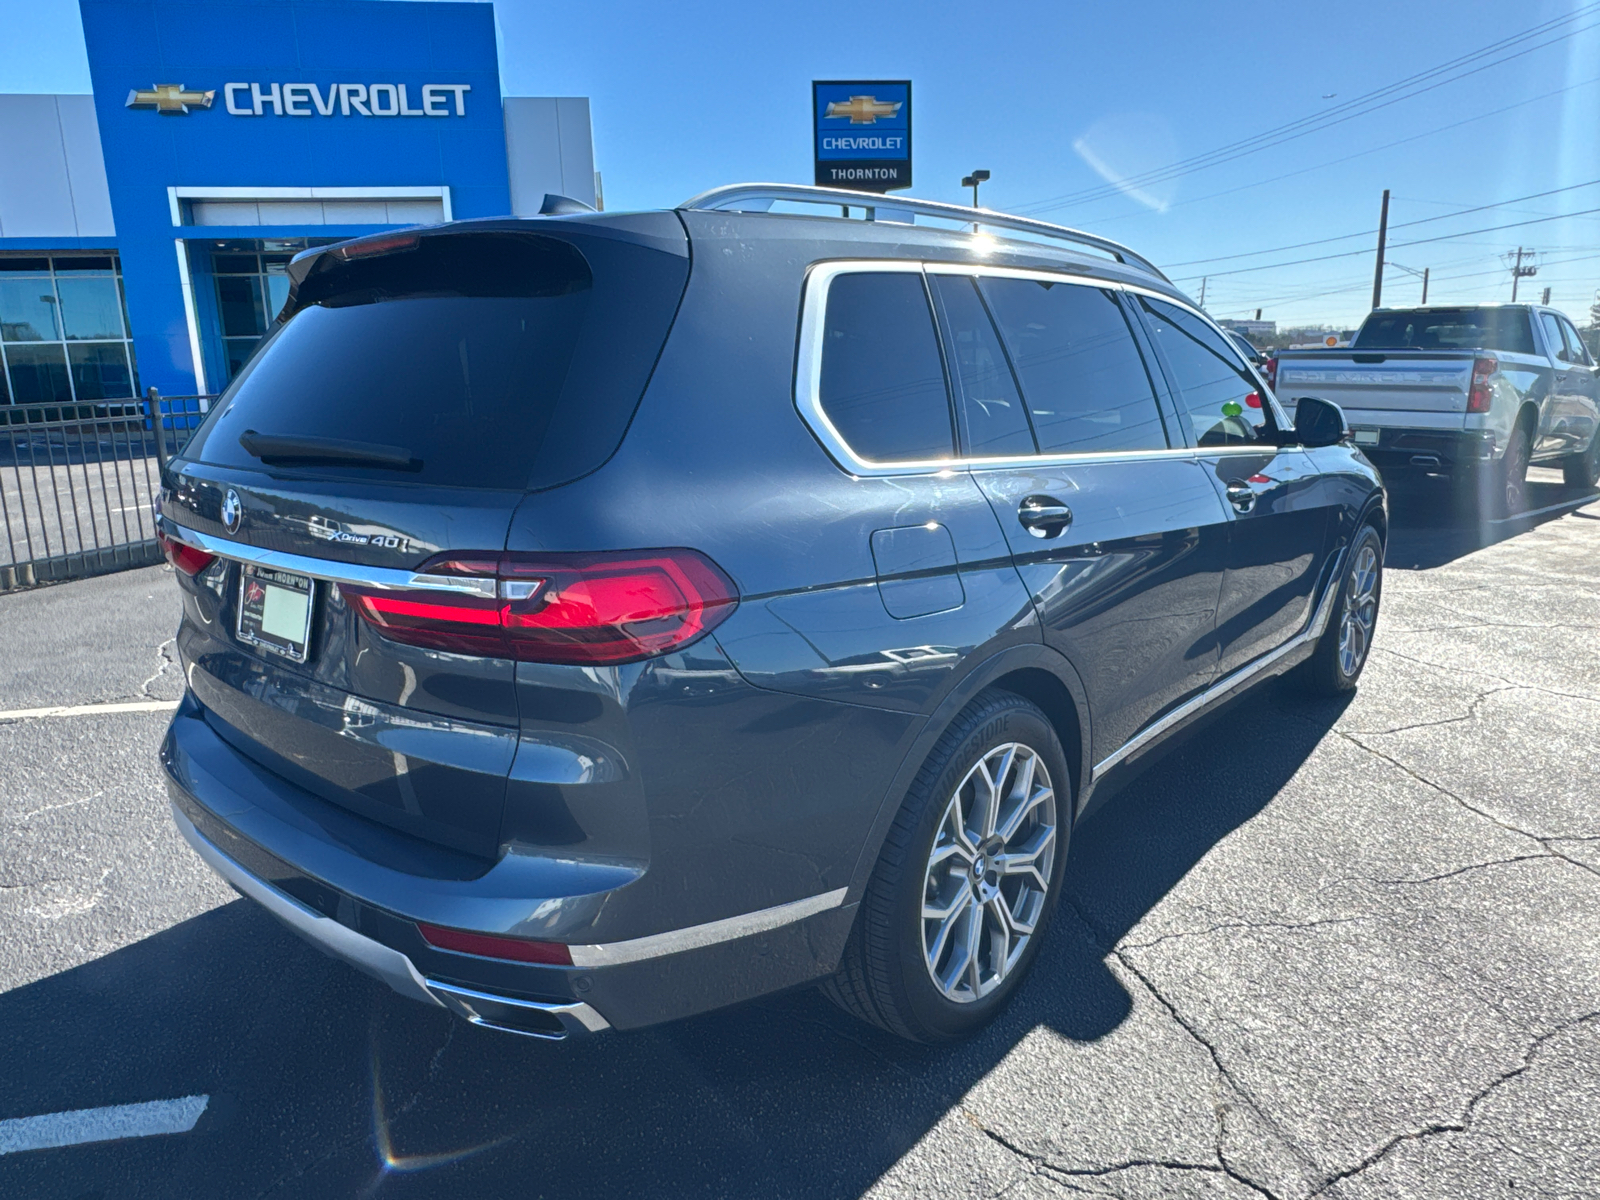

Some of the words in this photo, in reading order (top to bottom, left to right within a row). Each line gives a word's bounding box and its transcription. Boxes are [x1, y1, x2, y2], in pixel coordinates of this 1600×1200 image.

[224, 82, 471, 116] CHEVROLET
[823, 137, 903, 149] CHEVROLET
[831, 168, 897, 179] THORNTON
